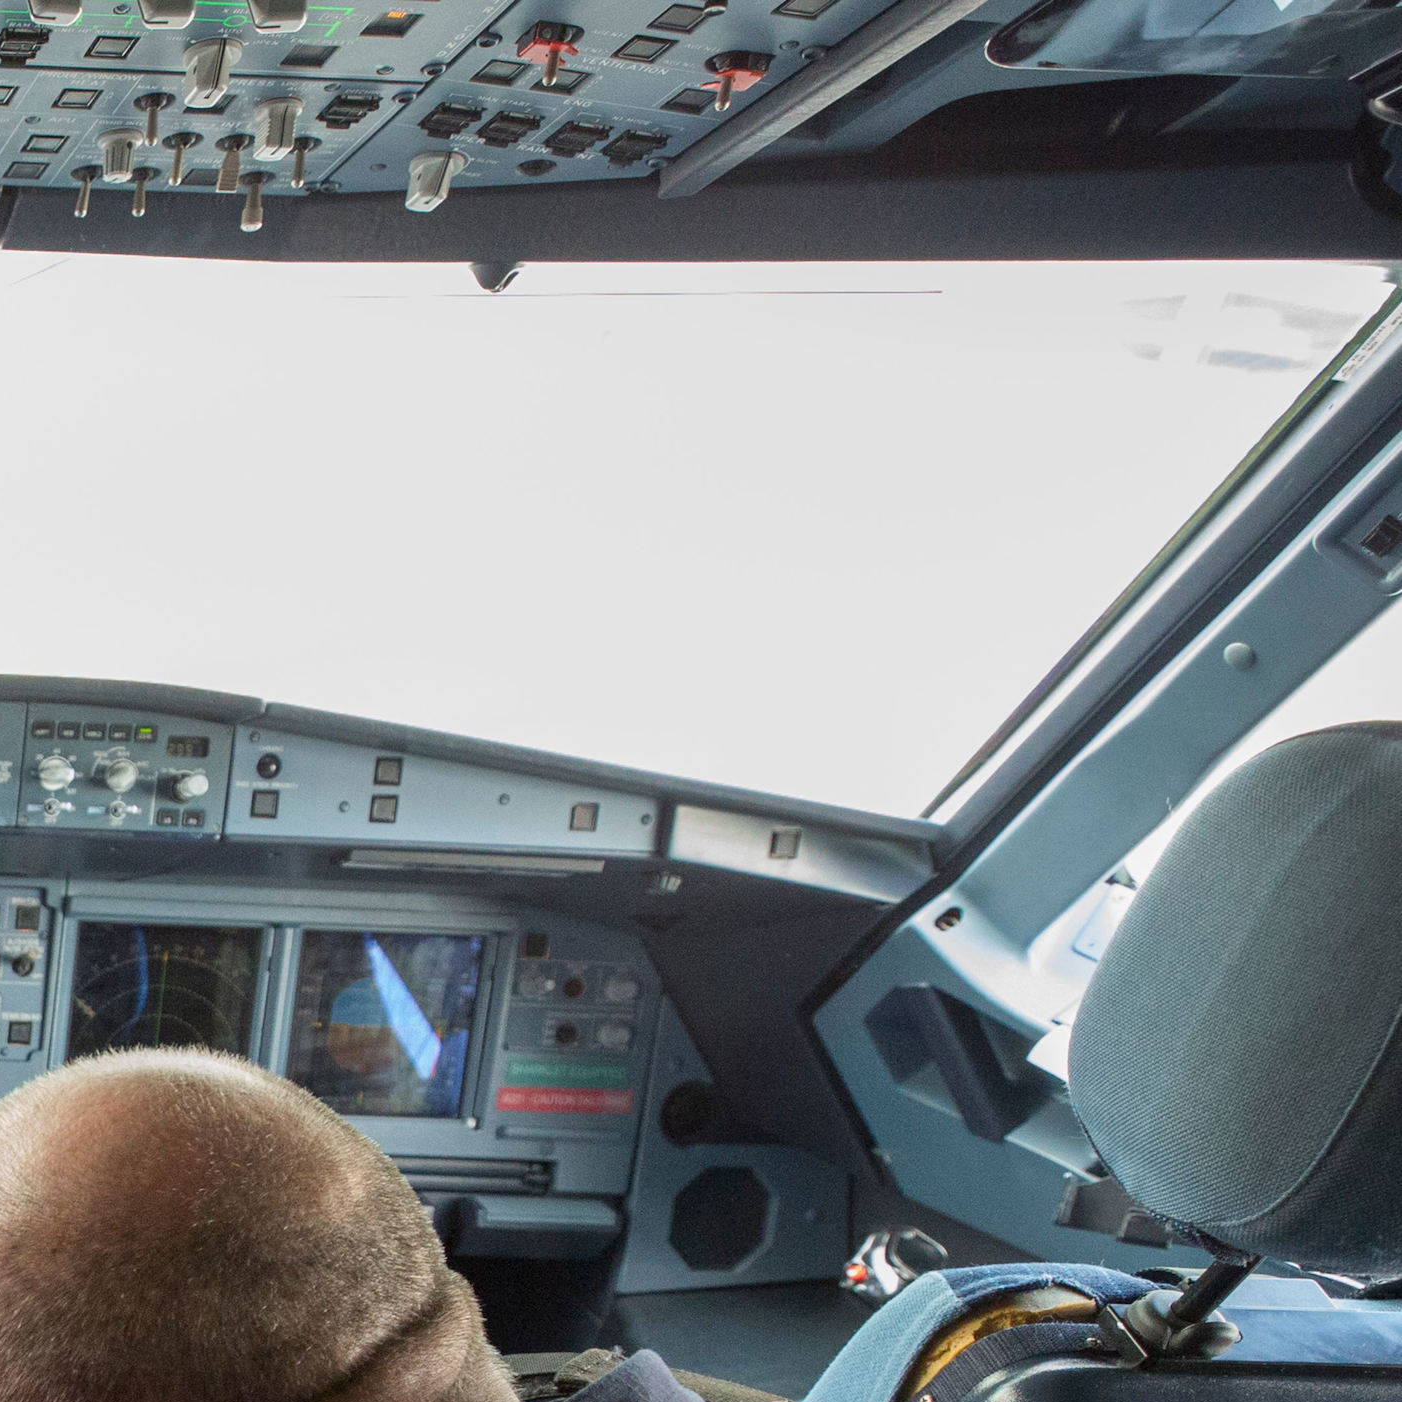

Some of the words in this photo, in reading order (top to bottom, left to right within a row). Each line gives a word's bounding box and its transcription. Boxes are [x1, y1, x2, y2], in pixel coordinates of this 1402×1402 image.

[581, 56, 669, 75] VENTILATION
[229, 79, 275, 88] PRESS
[502, 98, 531, 107] START
[563, 99, 593, 108] ENG
[516, 144, 550, 154] RAIN
